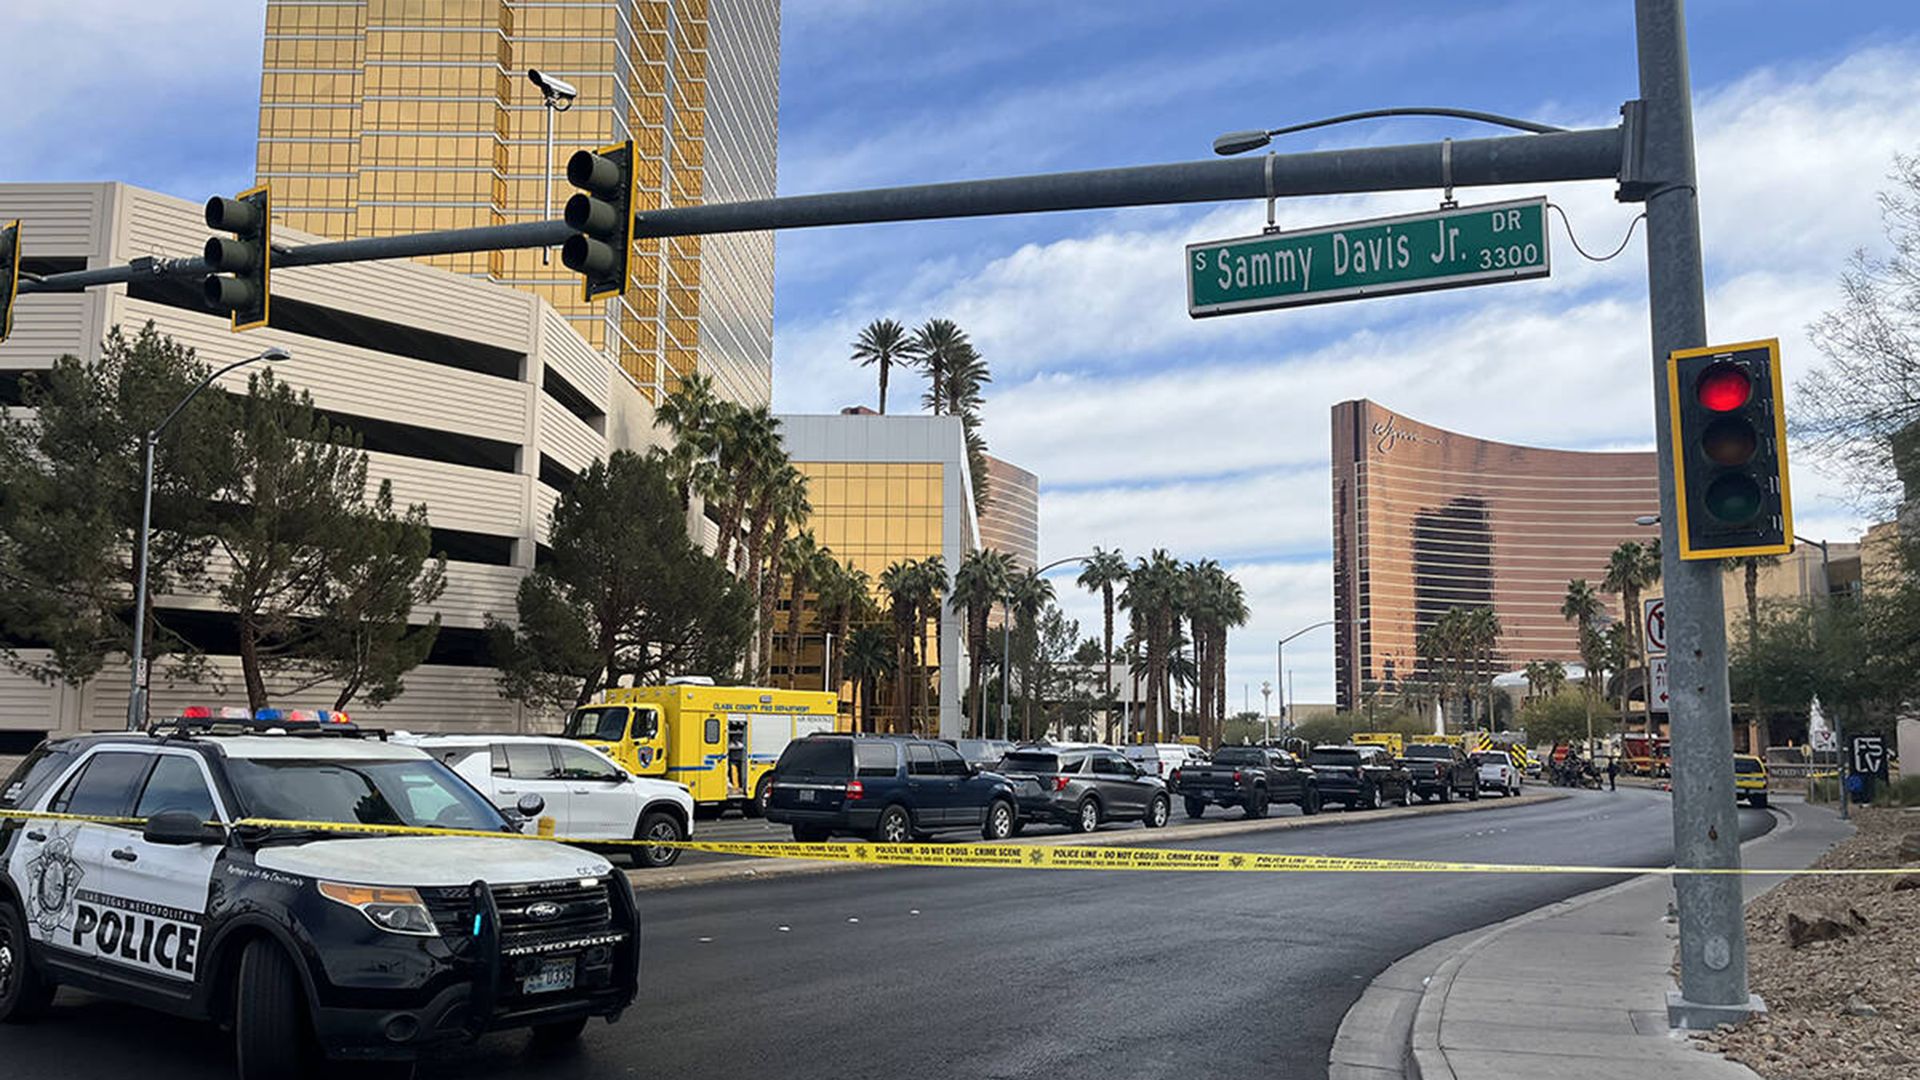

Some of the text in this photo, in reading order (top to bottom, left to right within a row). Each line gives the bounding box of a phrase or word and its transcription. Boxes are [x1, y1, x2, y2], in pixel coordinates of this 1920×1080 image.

[1492, 210, 1522, 232] DR
[1196, 220, 1466, 291] S Sammy Davis Jr.
[1480, 244, 1537, 270] 3300
[875, 846, 898, 854] POLICE
[900, 847, 914, 855] LINE
[920, 847, 930, 856] DO
[932, 847, 944, 856] NOT
[945, 847, 968, 856] CROSS
[974, 848, 997, 857] CRIME
[999, 848, 1021, 857] SCENE
[1052, 849, 1079, 858] POLICE
[1081, 850, 1097, 858] LINE
[1104, 851, 1116, 859] DO
[1117, 851, 1132, 860] NOT
[1133, 852, 1159, 860] CROSS
[1166, 853, 1192, 861] CRIME
[1194, 854, 1219, 862] SCENE
[85, 892, 196, 922] LAS VEGAS METROPOLITAN
[73, 904, 197, 975] POLICE
